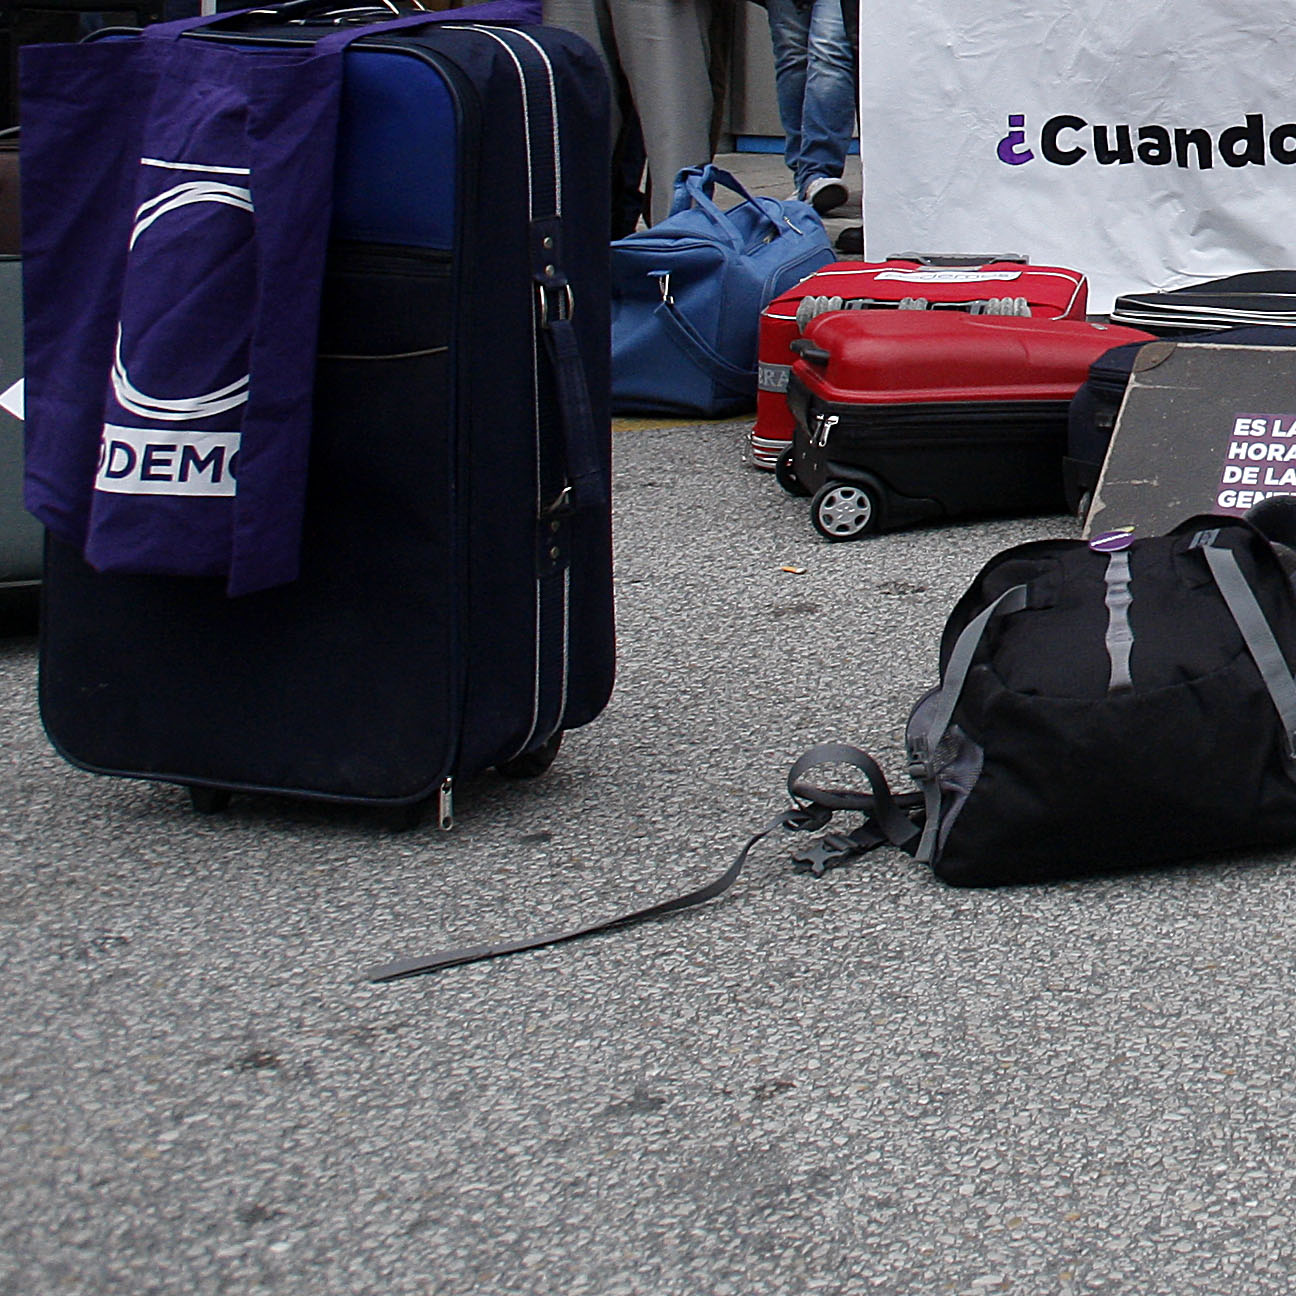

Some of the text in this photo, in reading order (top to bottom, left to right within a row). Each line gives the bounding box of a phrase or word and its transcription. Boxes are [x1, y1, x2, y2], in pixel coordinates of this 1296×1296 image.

[1233, 418, 1267, 437] ES
[99, 437, 240, 484] DEM
[1222, 465, 1259, 485] DE
